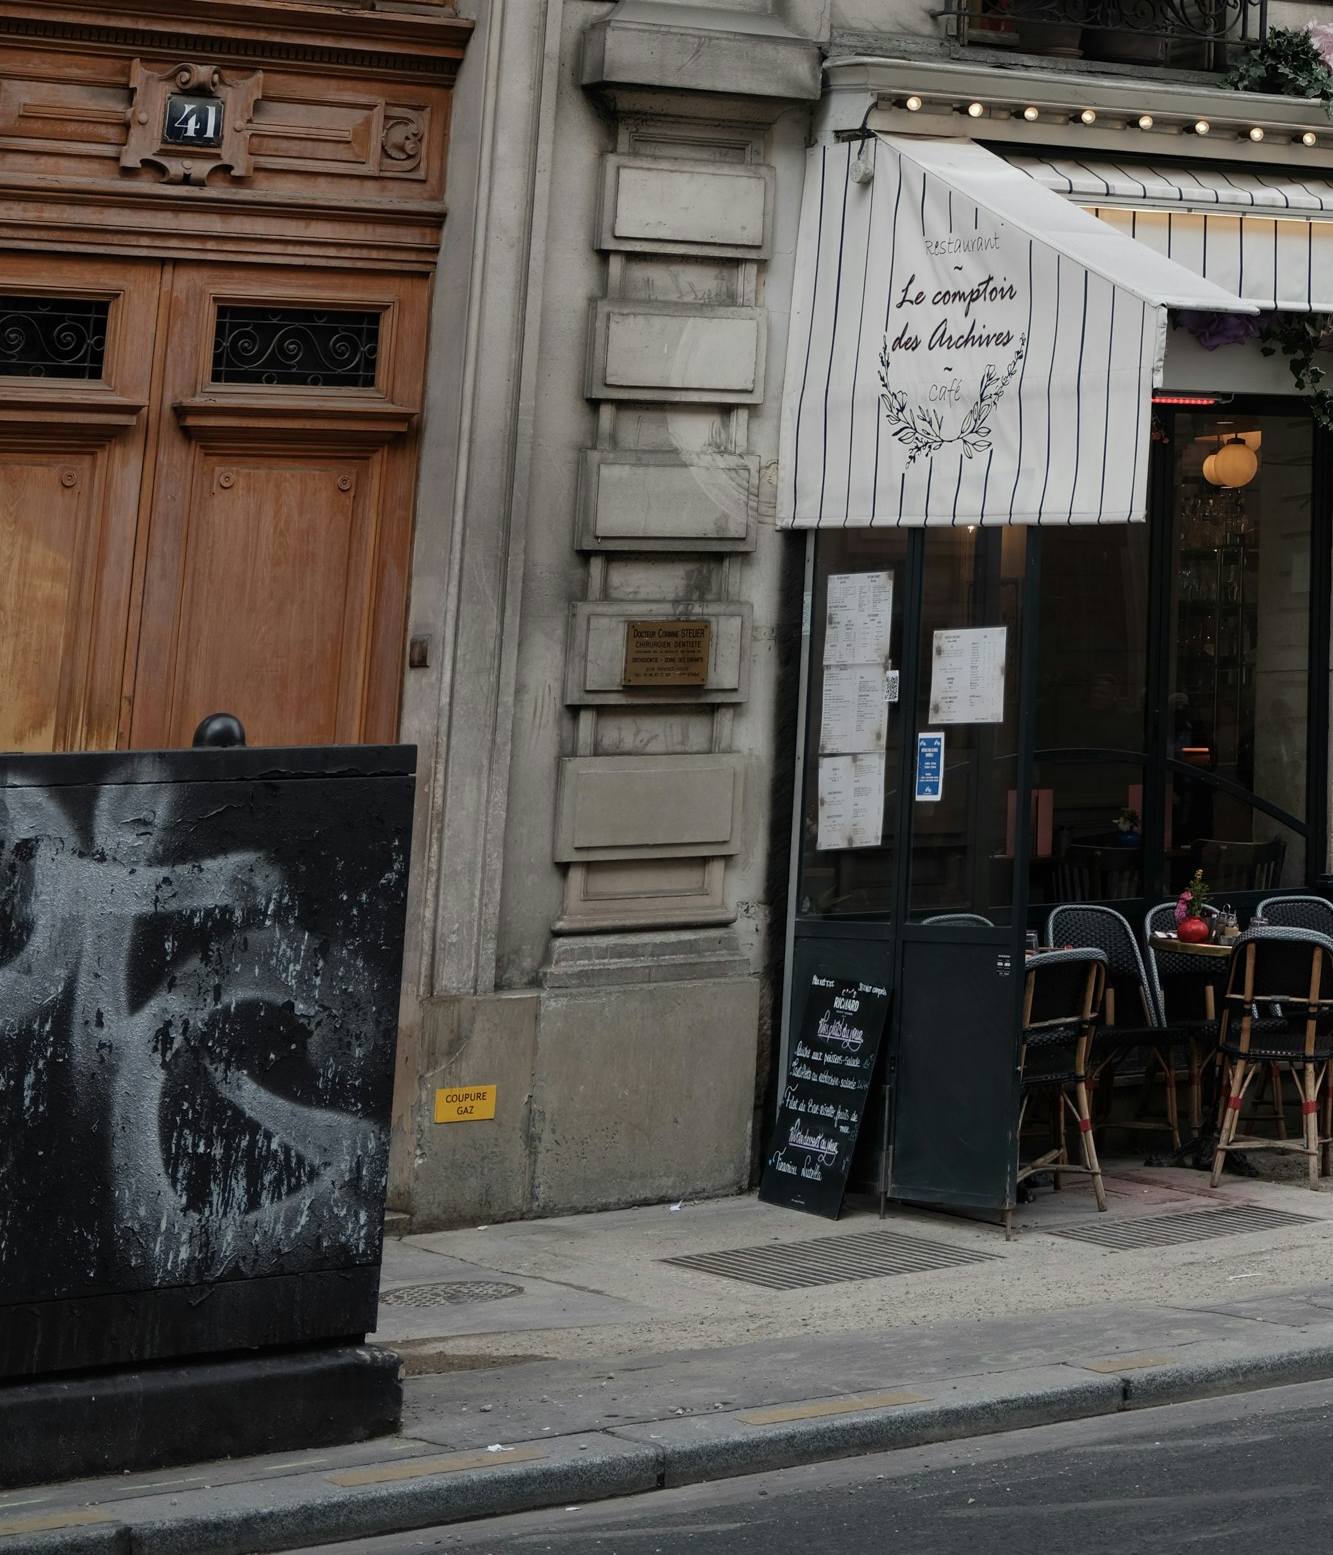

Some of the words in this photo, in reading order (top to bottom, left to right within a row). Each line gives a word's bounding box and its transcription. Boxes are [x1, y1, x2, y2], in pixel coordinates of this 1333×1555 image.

[174, 104, 216, 138] 41
[925, 232, 1000, 256] Restaurant
[896, 274, 926, 308] Le
[931, 274, 1017, 318] comptoir
[891, 321, 921, 352] des
[928, 318, 1014, 351] Archives
[681, 628, 705, 638] STEUER
[635, 641, 670, 649] CHIRURGIEN
[445, 1092, 488, 1104] COUPURE
[456, 1105, 474, 1116] GAZ
